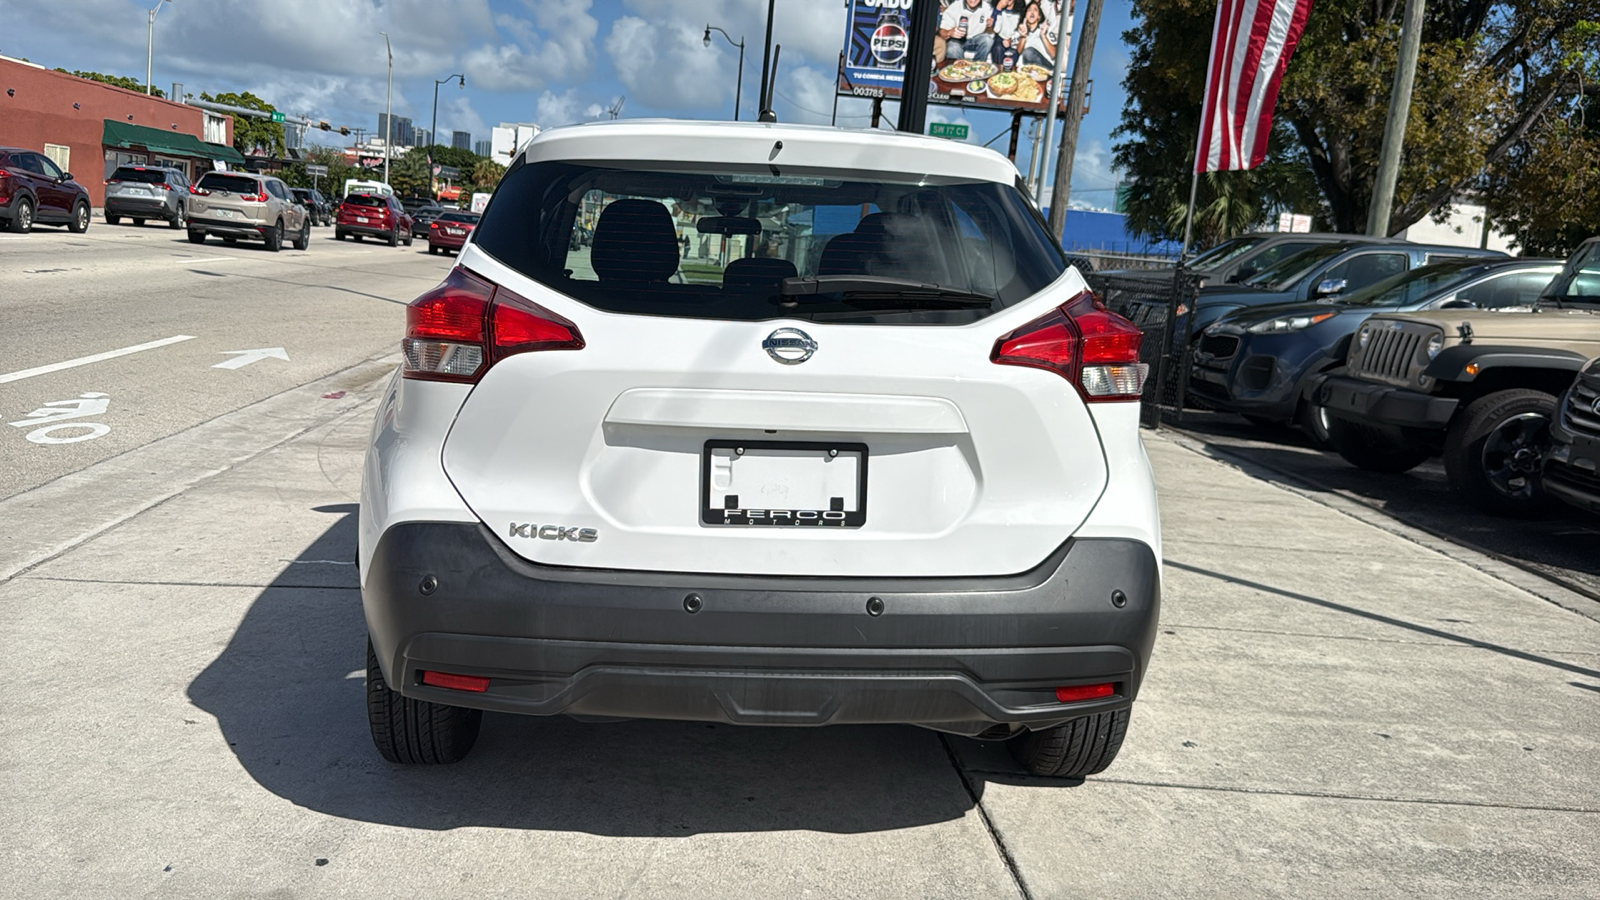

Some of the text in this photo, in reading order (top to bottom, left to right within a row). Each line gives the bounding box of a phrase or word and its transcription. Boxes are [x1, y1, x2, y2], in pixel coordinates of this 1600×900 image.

[873, 38, 906, 49] PEPSI
[853, 87, 884, 98] 003785
[933, 125, 945, 134] SW
[946, 126, 955, 134] 17
[724, 509, 846, 520] FERCO
[724, 518, 846, 527] MOTORS
[509, 522, 599, 543] KICKS
